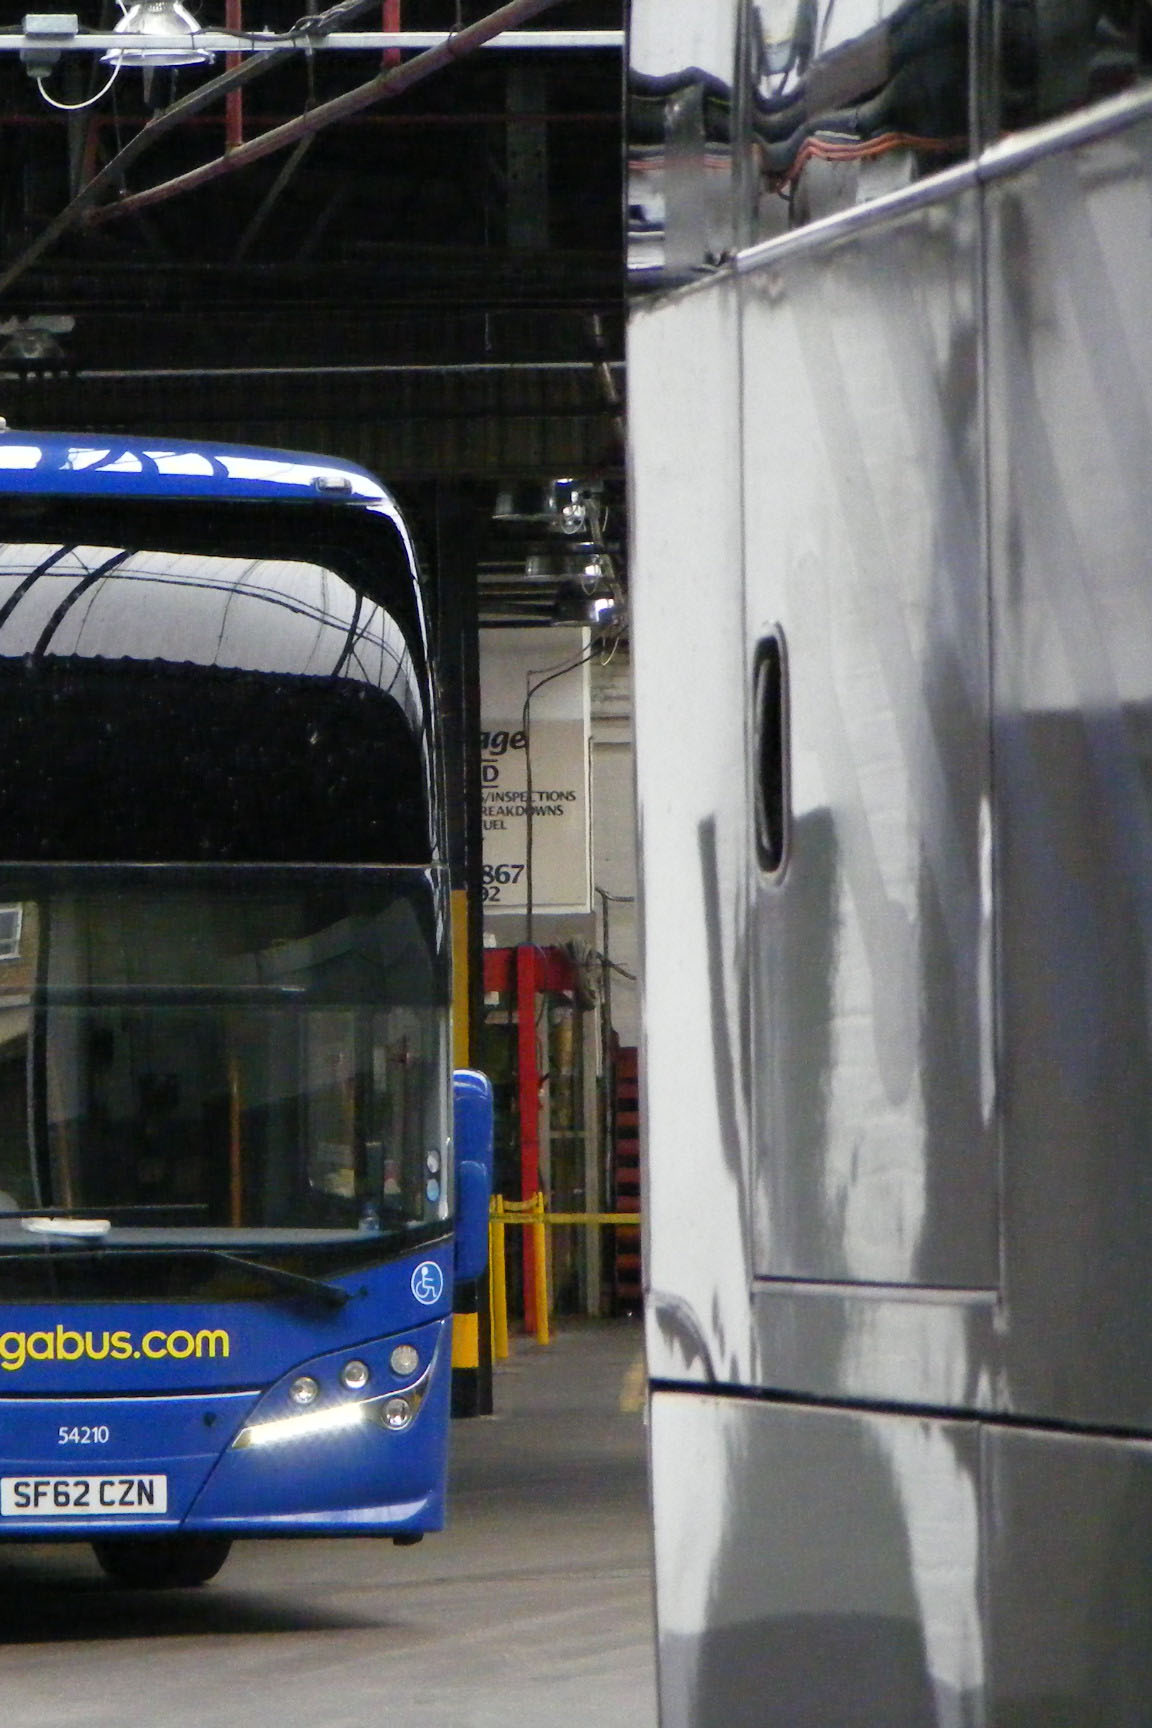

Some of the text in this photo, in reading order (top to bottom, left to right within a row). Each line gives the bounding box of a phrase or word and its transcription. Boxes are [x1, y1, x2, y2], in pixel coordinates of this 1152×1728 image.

[57, 1425, 110, 1445] 54210
[13, 1478, 155, 1508] SF62 CZN
